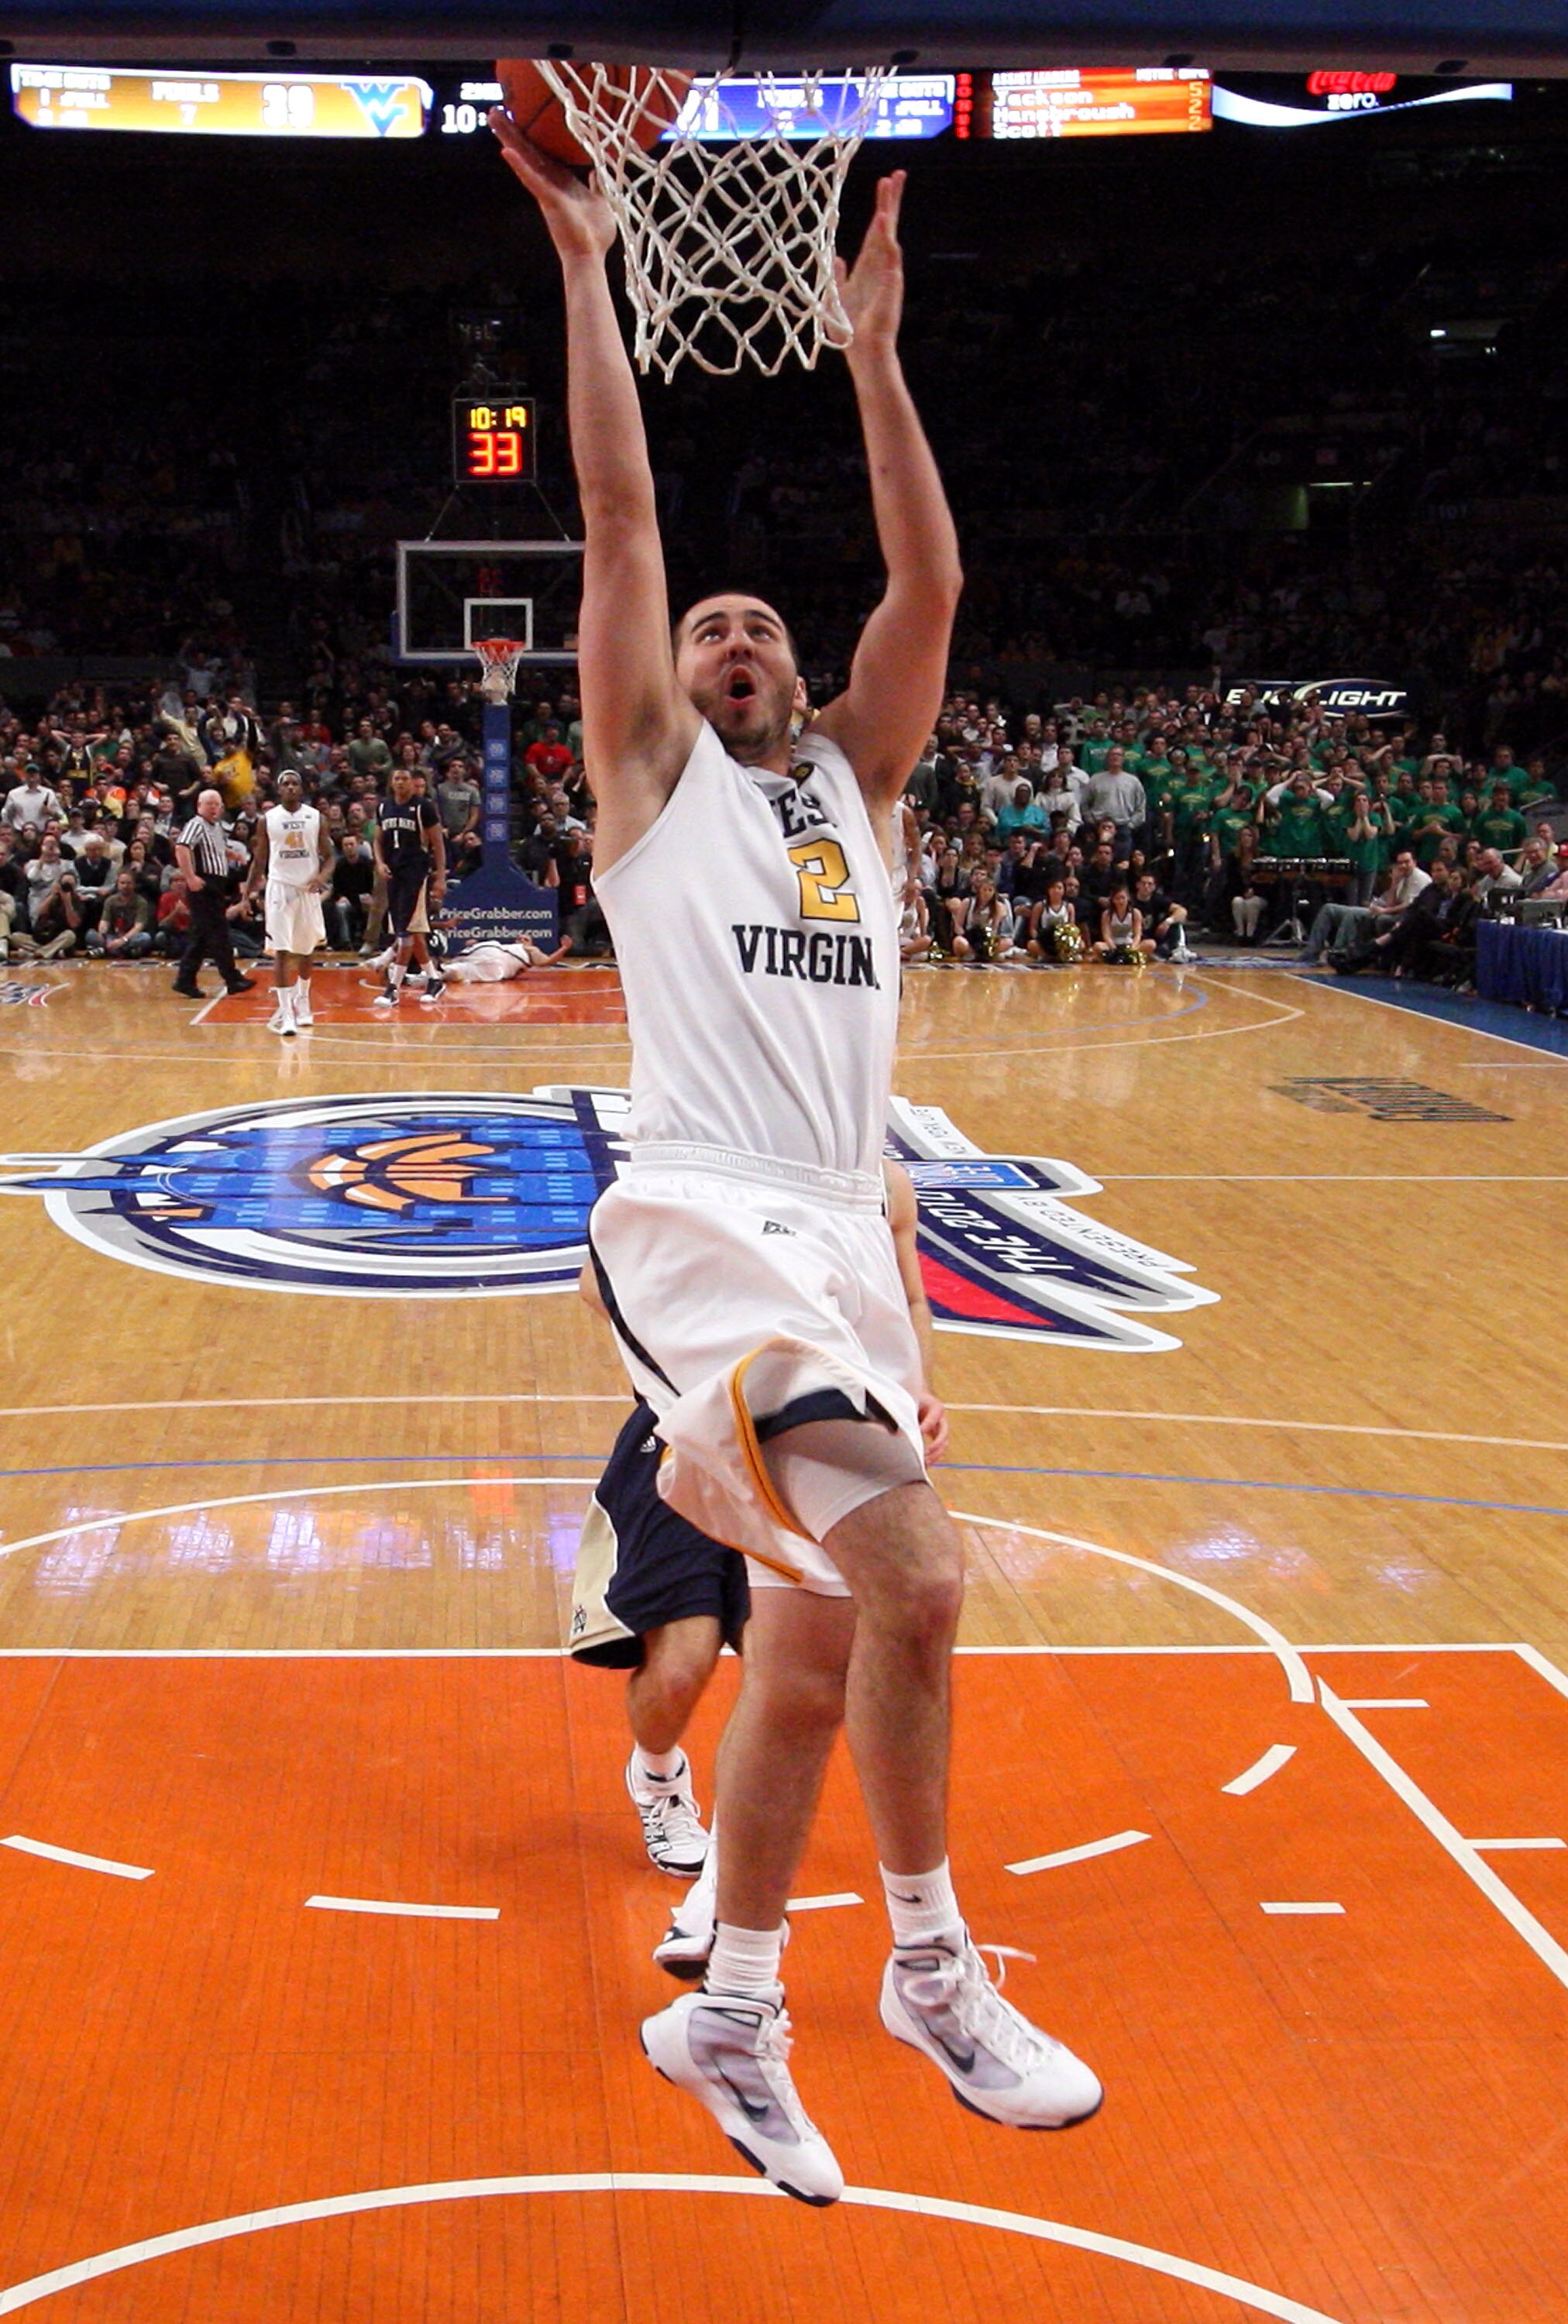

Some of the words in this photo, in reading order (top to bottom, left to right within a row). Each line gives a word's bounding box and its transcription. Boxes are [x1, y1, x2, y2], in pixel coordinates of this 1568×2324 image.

[1189, 81, 1203, 97] 5
[1188, 99, 1202, 115] 2
[1188, 116, 1202, 131] 2
[470, 406, 527, 429] 10:19
[467, 431, 523, 476] 33
[393, 830, 400, 849] 1
[787, 837, 861, 923] 2
[438, 906, 552, 920] PriceGrabber.com
[732, 924, 881, 990] VIRGIN
[915, 1191, 1002, 1230] 2010
[965, 1233, 1075, 1273] THE
